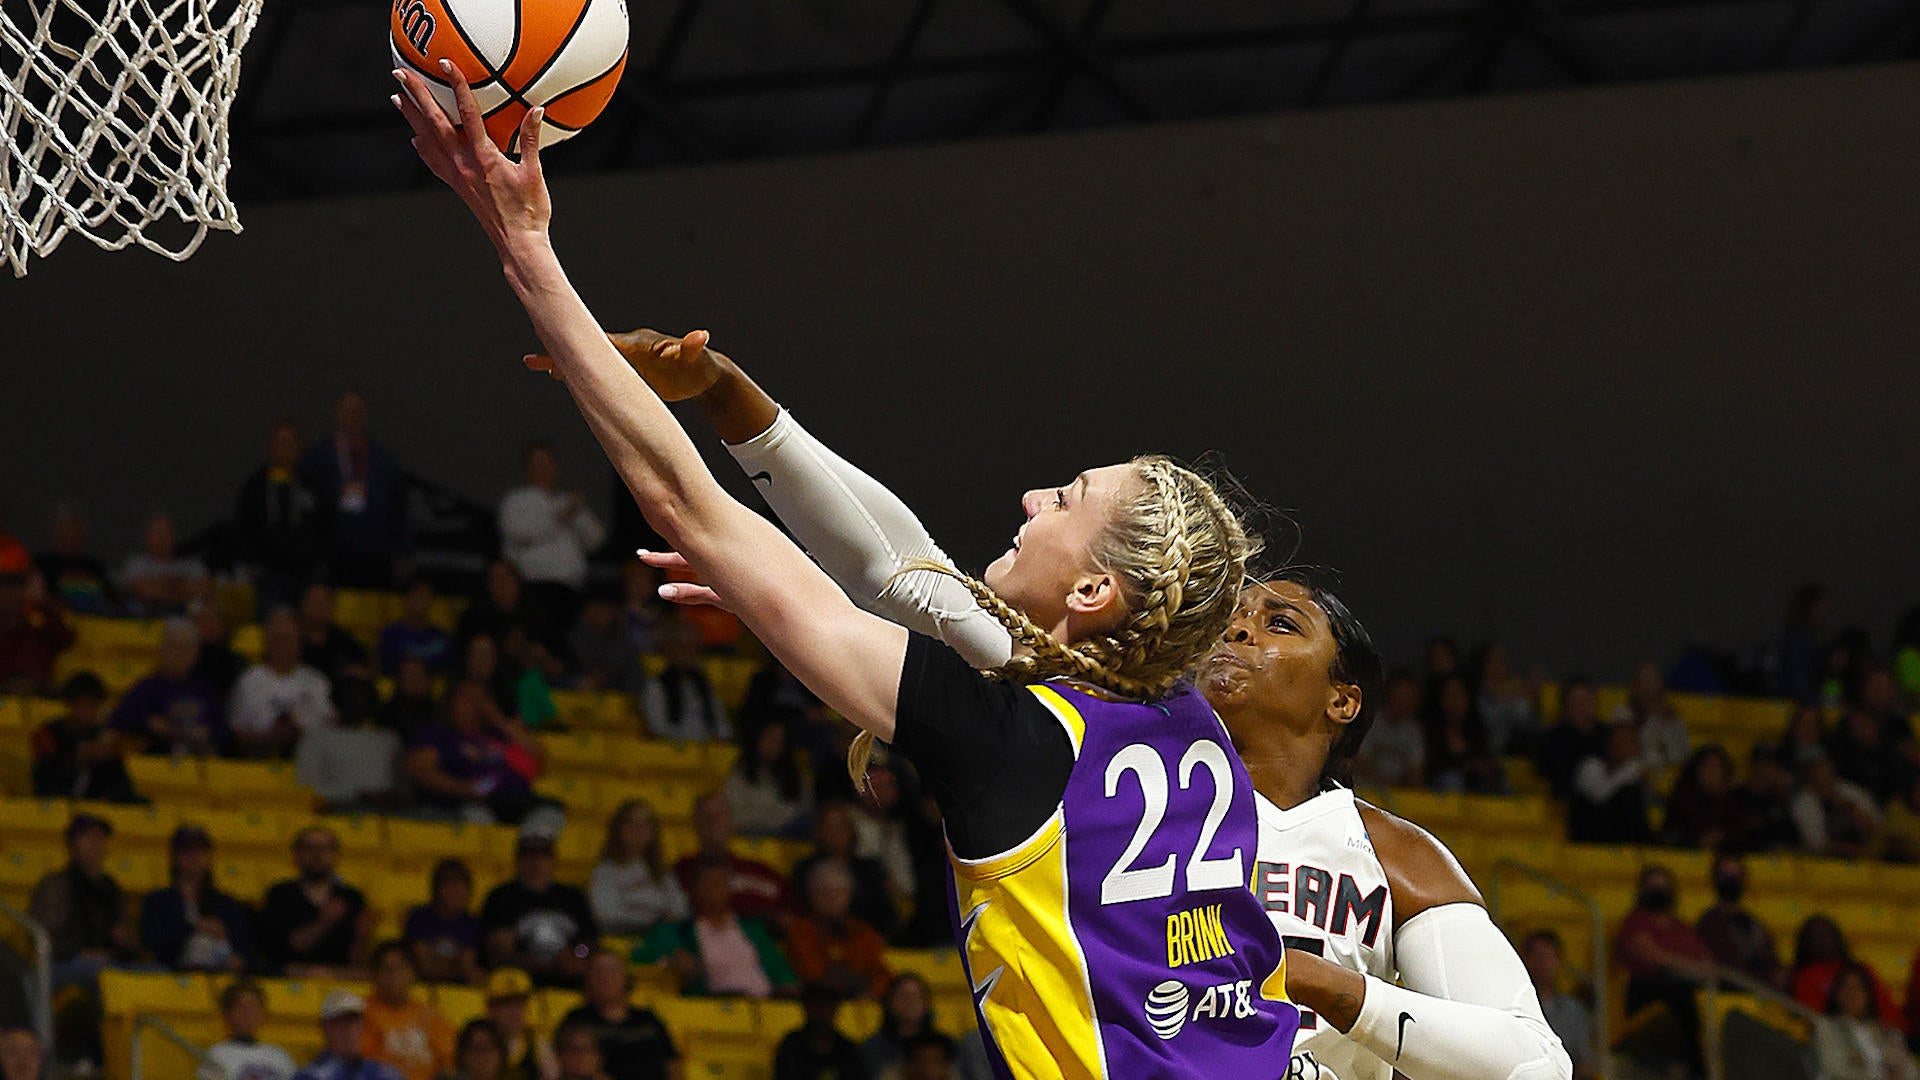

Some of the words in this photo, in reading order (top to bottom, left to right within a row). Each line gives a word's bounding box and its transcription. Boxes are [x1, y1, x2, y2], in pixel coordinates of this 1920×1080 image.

[1101, 739, 1244, 906] 22
[1166, 903, 1235, 969] BRINK
[1257, 860, 1388, 949] EAM
[1192, 979, 1257, 1023] AT&
